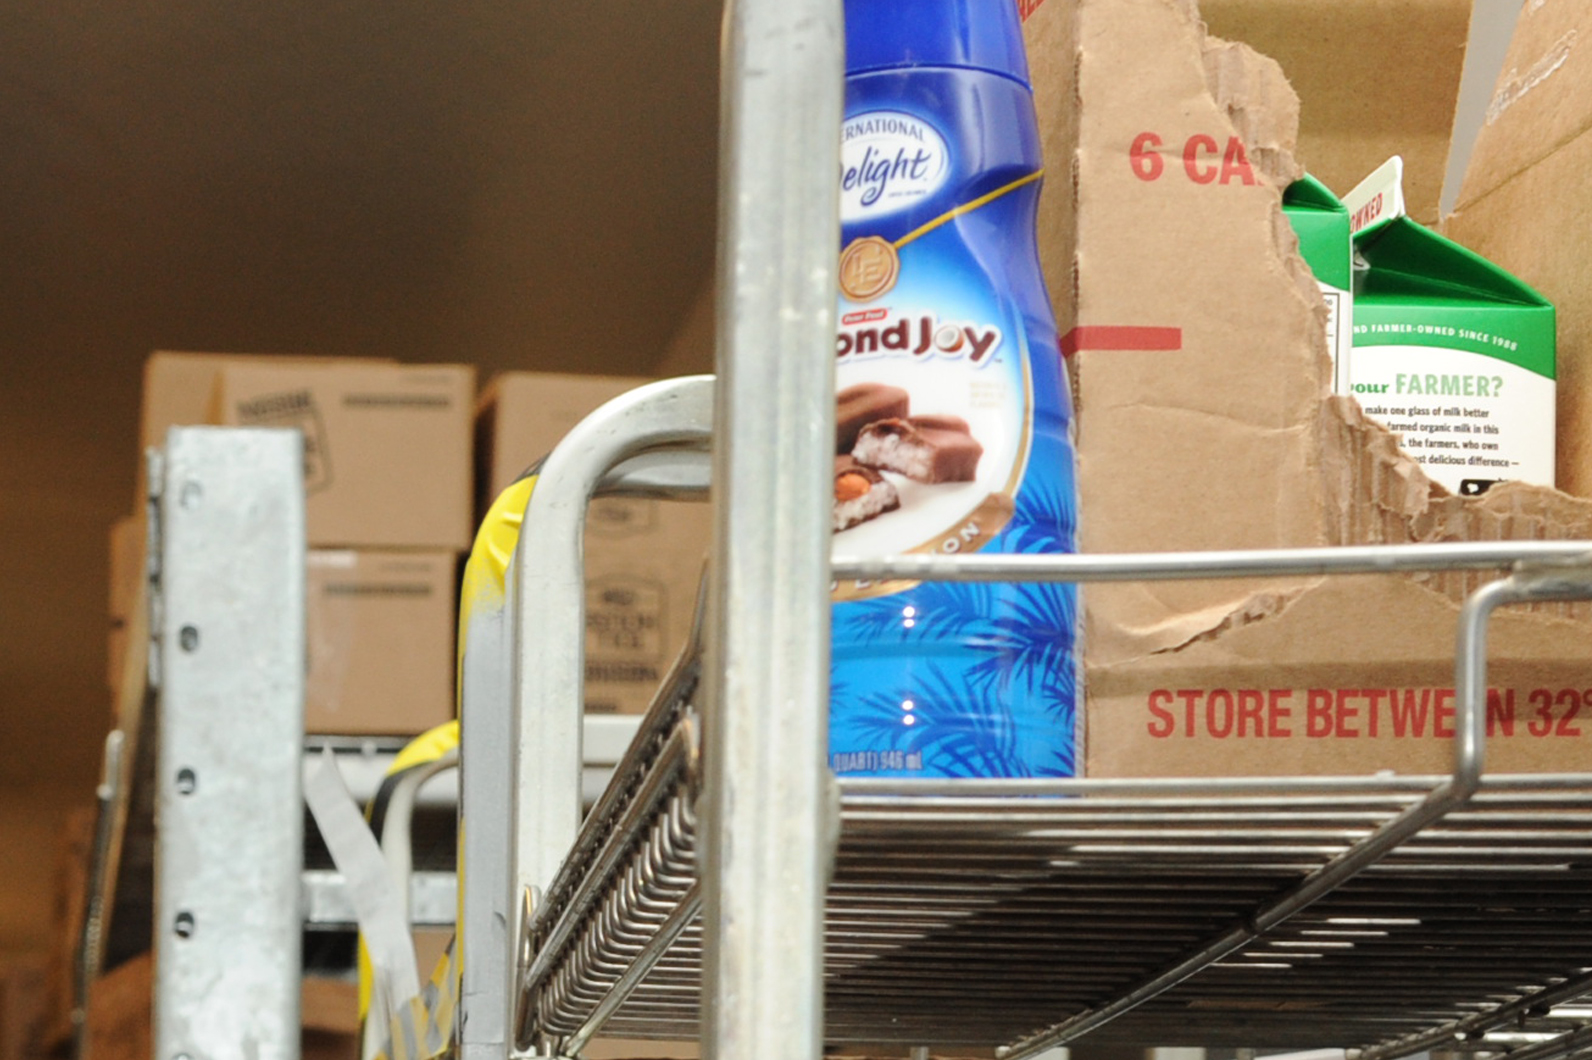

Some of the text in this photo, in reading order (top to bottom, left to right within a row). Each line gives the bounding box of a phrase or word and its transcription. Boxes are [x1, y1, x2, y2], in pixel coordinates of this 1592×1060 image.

[843, 118, 925, 142] RNATIONAL
[1129, 131, 1266, 187] 6 CA
[840, 145, 932, 207] elight
[836, 318, 910, 358] ond
[1352, 323, 1519, 352] ND FARMER-OWNED SINCE 1988
[1394, 372, 1504, 398] FARMER?
[1364, 405, 1490, 418] make one glass of milk better
[1420, 424, 1451, 434] organic
[1453, 423, 1471, 433] milk
[1473, 424, 1482, 434] in
[1483, 425, 1500, 435] this
[1408, 438, 1423, 448] the
[1424, 438, 1460, 450] farmers,
[1462, 440, 1480, 450] who
[1482, 442, 1499, 451] own
[1413, 454, 1510, 468] ost delicious difference
[1146, 688, 1293, 739] STORE
[1305, 688, 1515, 739] BETWEN
